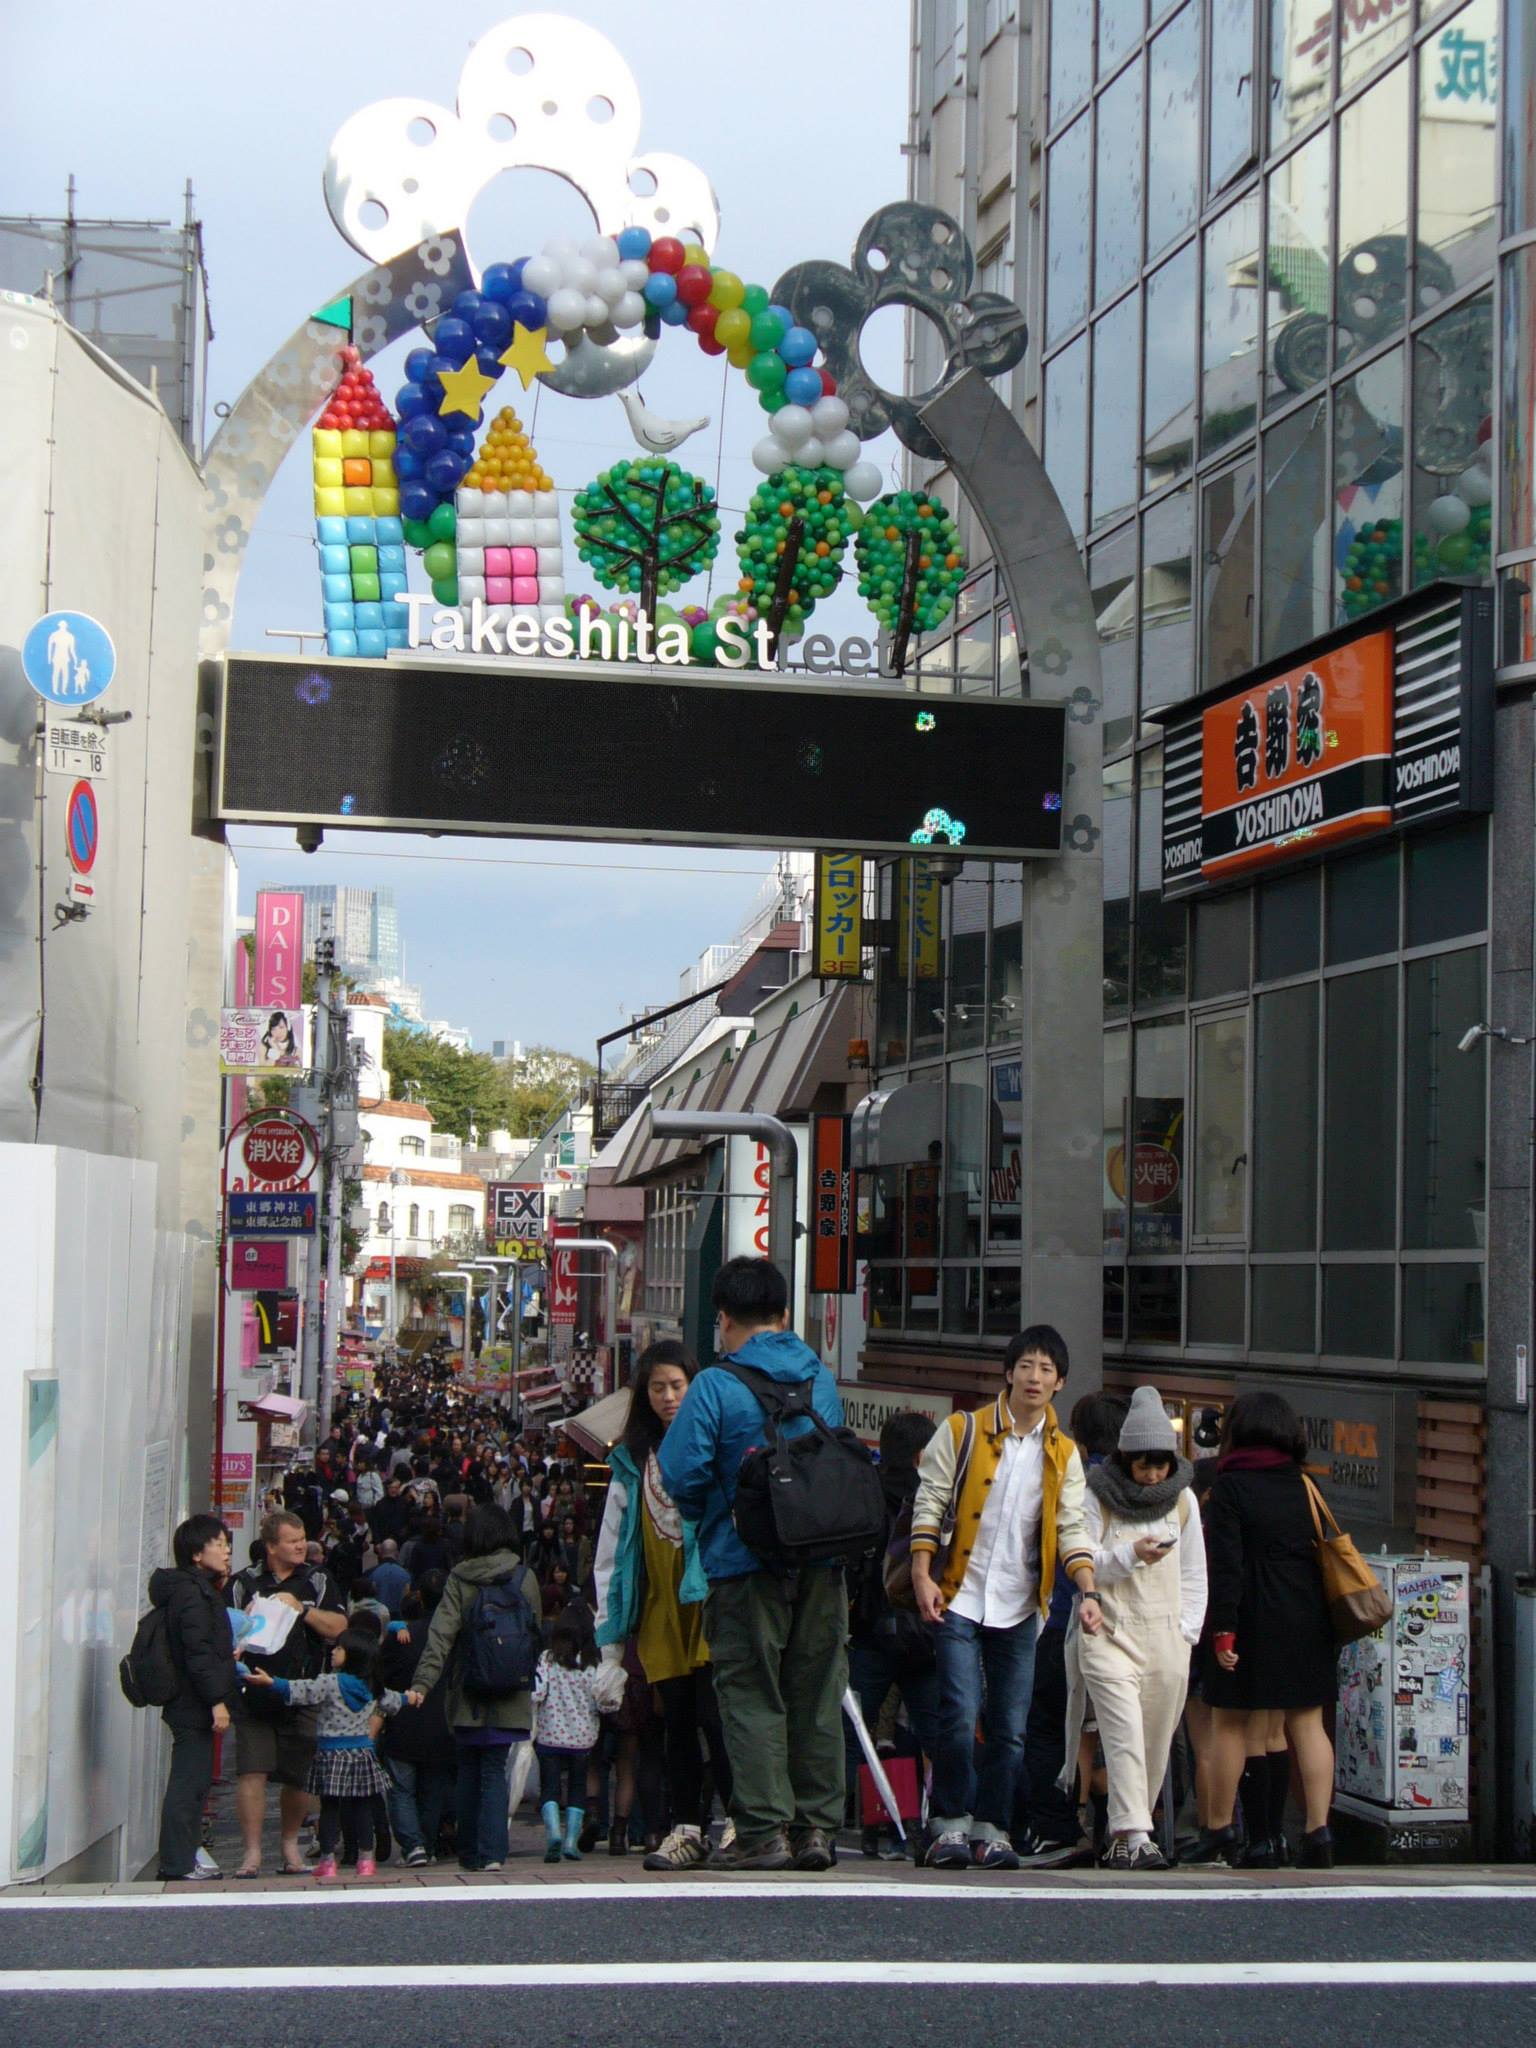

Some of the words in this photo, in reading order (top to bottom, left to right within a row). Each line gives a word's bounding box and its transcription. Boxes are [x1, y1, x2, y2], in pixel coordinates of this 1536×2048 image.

[394, 592, 690, 665] Takeshita
[714, 615, 899, 678] Street
[50, 727, 106, 751] 自転車を除く
[1395, 744, 1461, 793] YOSHINOYA
[1234, 781, 1324, 847] YOSHINOYA
[1164, 836, 1202, 870] YOSHINO
[823, 960, 858, 974] 3F
[248, 1138, 301, 1164] 消火栓
[841, 1170, 850, 1236] YOSHINOYA
[496, 1221, 538, 1238] LIVE
